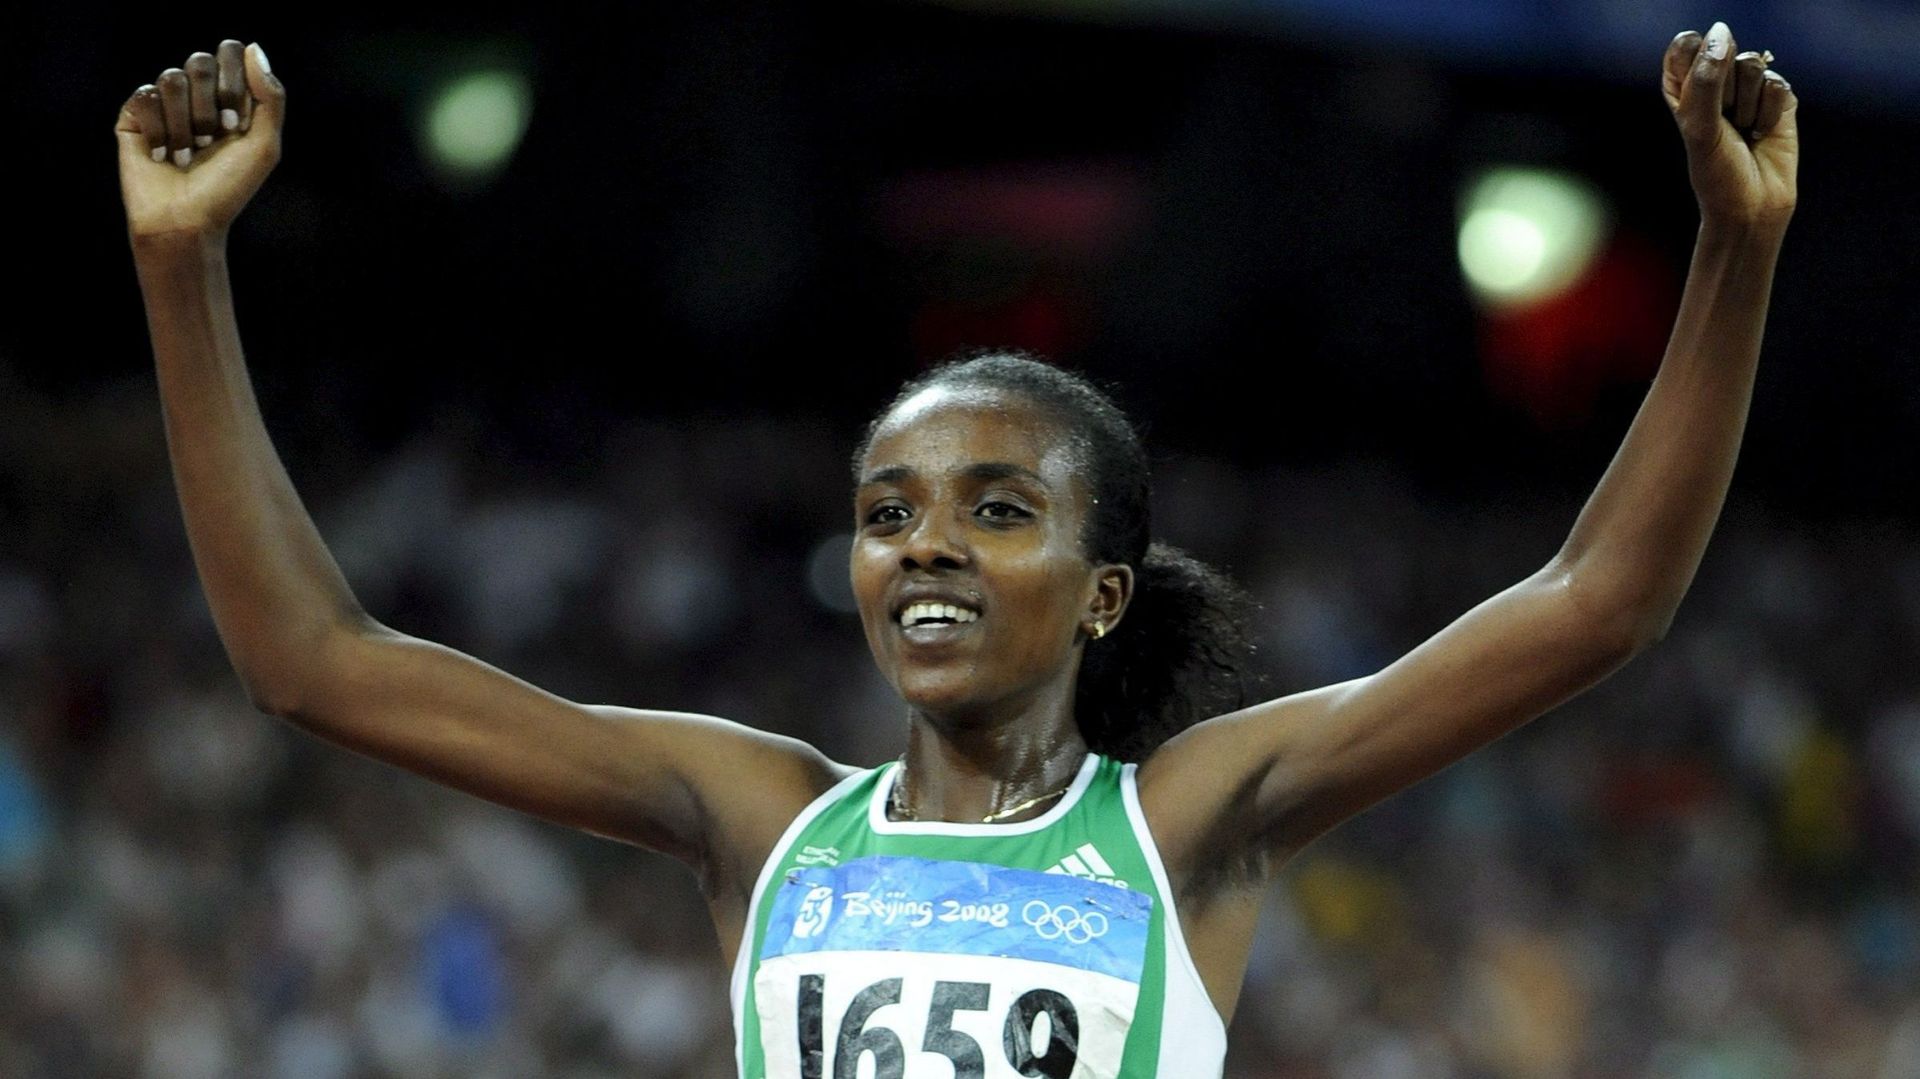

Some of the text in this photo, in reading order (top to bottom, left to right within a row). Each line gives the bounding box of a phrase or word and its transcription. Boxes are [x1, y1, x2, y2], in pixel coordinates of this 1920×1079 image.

[841, 891, 1010, 928] Beijing 2008
[798, 973, 1080, 1079] 1659
